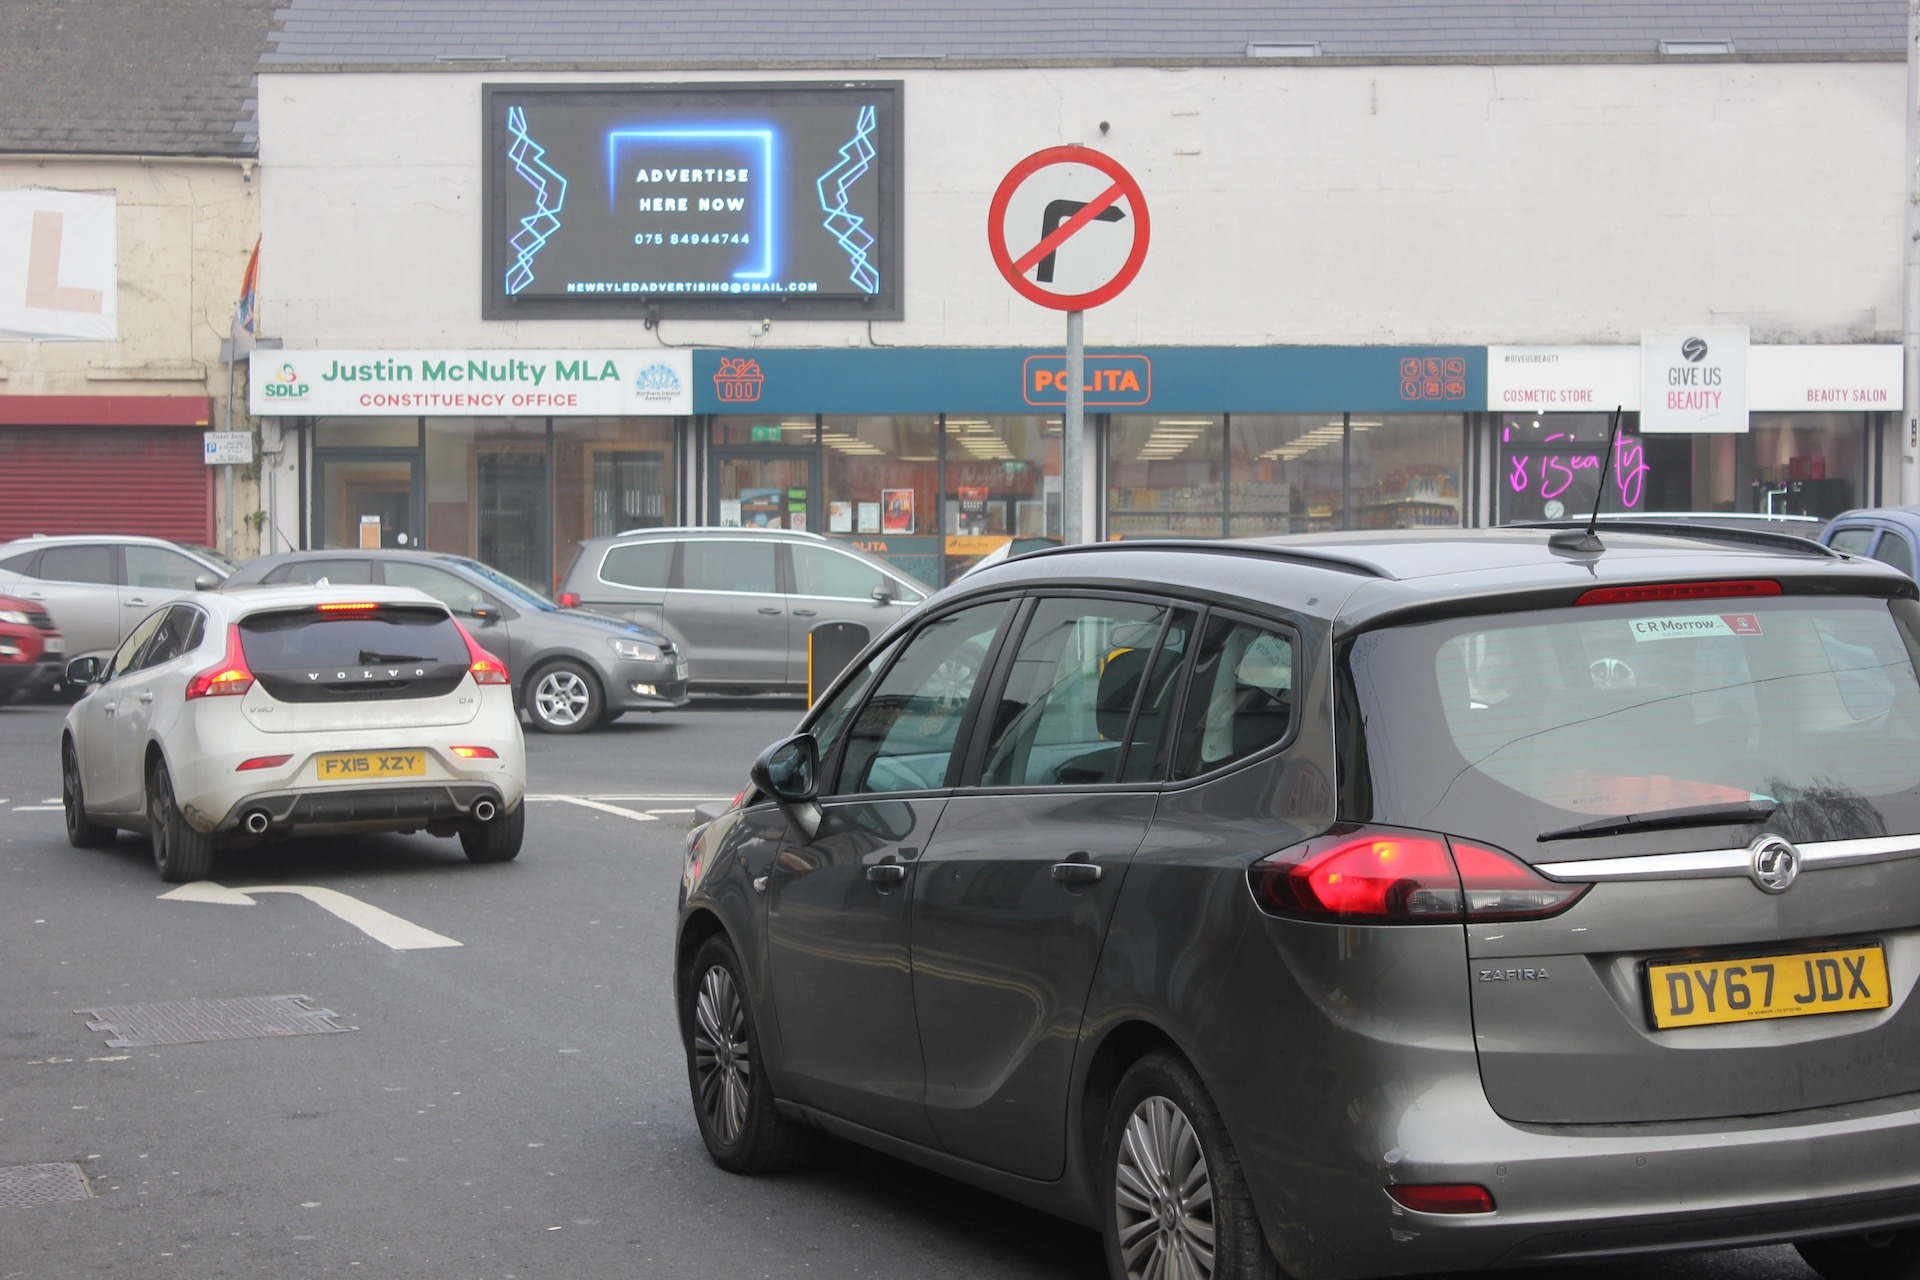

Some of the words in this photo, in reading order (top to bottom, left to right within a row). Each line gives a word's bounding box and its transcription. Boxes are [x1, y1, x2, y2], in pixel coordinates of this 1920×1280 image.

[636, 169, 749, 183] ADVERTISE
[639, 198, 688, 212] HERE
[698, 198, 745, 212] NOW
[634, 233, 663, 245] 075
[670, 233, 750, 245] 84944744
[567, 282, 818, 293] NEWRYLEDADVERTISING@GMAIL.COM
[1504, 354, 1560, 363] #GIVEUSBEAUTY
[322, 358, 413, 382] Justin
[422, 359, 547, 387] McNulty
[555, 360, 621, 381] MLA
[1668, 367, 1699, 386] GIVE
[1703, 367, 1722, 386] US
[265, 384, 309, 397] SDLP
[1503, 390, 1556, 403] COSMETIC
[1560, 389, 1594, 403] STORE
[1807, 389, 1848, 402] BEAUTY
[1853, 389, 1887, 402] SALON
[360, 394, 505, 407] CONSTITUENCY
[512, 393, 577, 407] OFFICE
[1668, 390, 1722, 410] BEAUTY
[1660, 619, 1714, 632] Morrow
[308, 669, 424, 681] VOLVO
[325, 757, 370, 774] FX15
[378, 755, 415, 771] XZY
[1479, 968, 1550, 982] ZAFIRA
[1665, 964, 1775, 1016] DY67
[1794, 956, 1871, 1004] JDX
